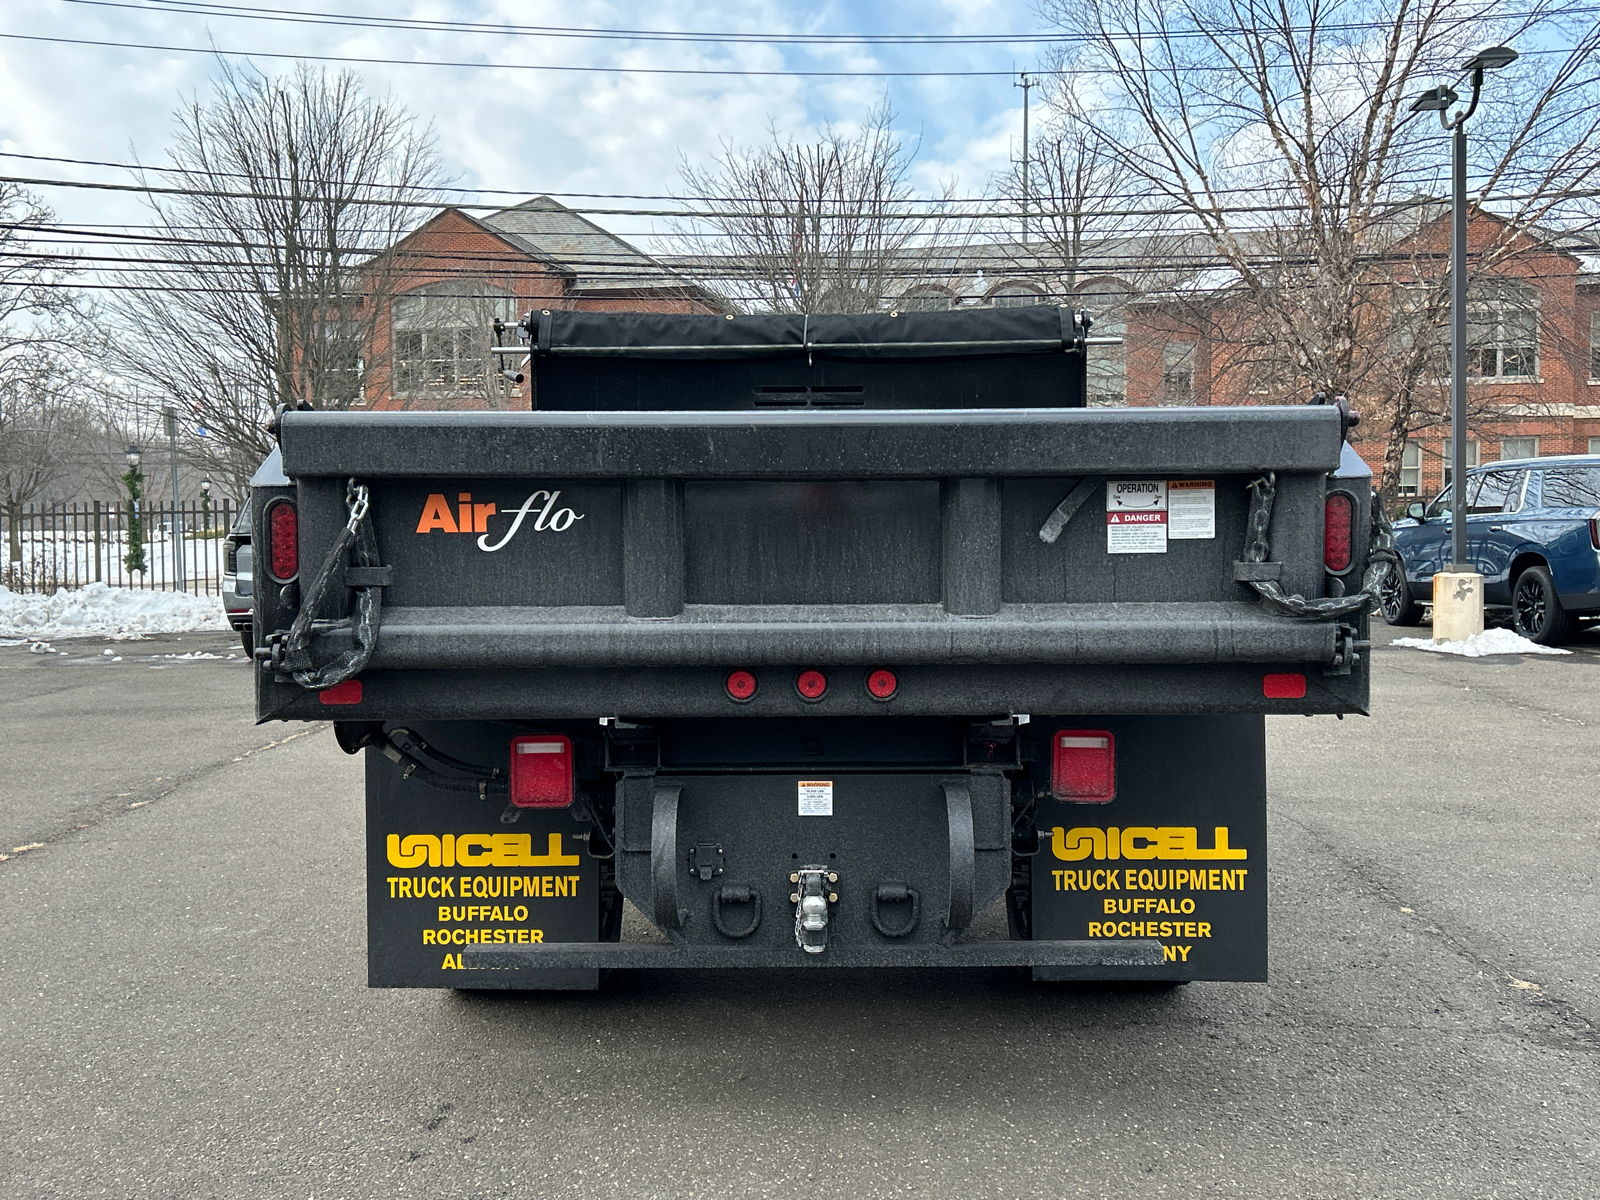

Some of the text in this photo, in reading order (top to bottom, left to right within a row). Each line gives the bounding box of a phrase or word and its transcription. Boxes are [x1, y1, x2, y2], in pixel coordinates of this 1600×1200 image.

[1117, 484, 1158, 493] OPERATION
[416, 490, 585, 552] Air flo
[387, 876, 580, 898] TRUCK EQUIPMENT
[1052, 869, 1247, 891] TRUCK EQUIPMENT
[438, 906, 528, 921] BUFFALO
[1104, 898, 1195, 914] BUFFALO
[423, 929, 543, 945] ROCHESTER
[1089, 922, 1211, 937] ROCHESTER
